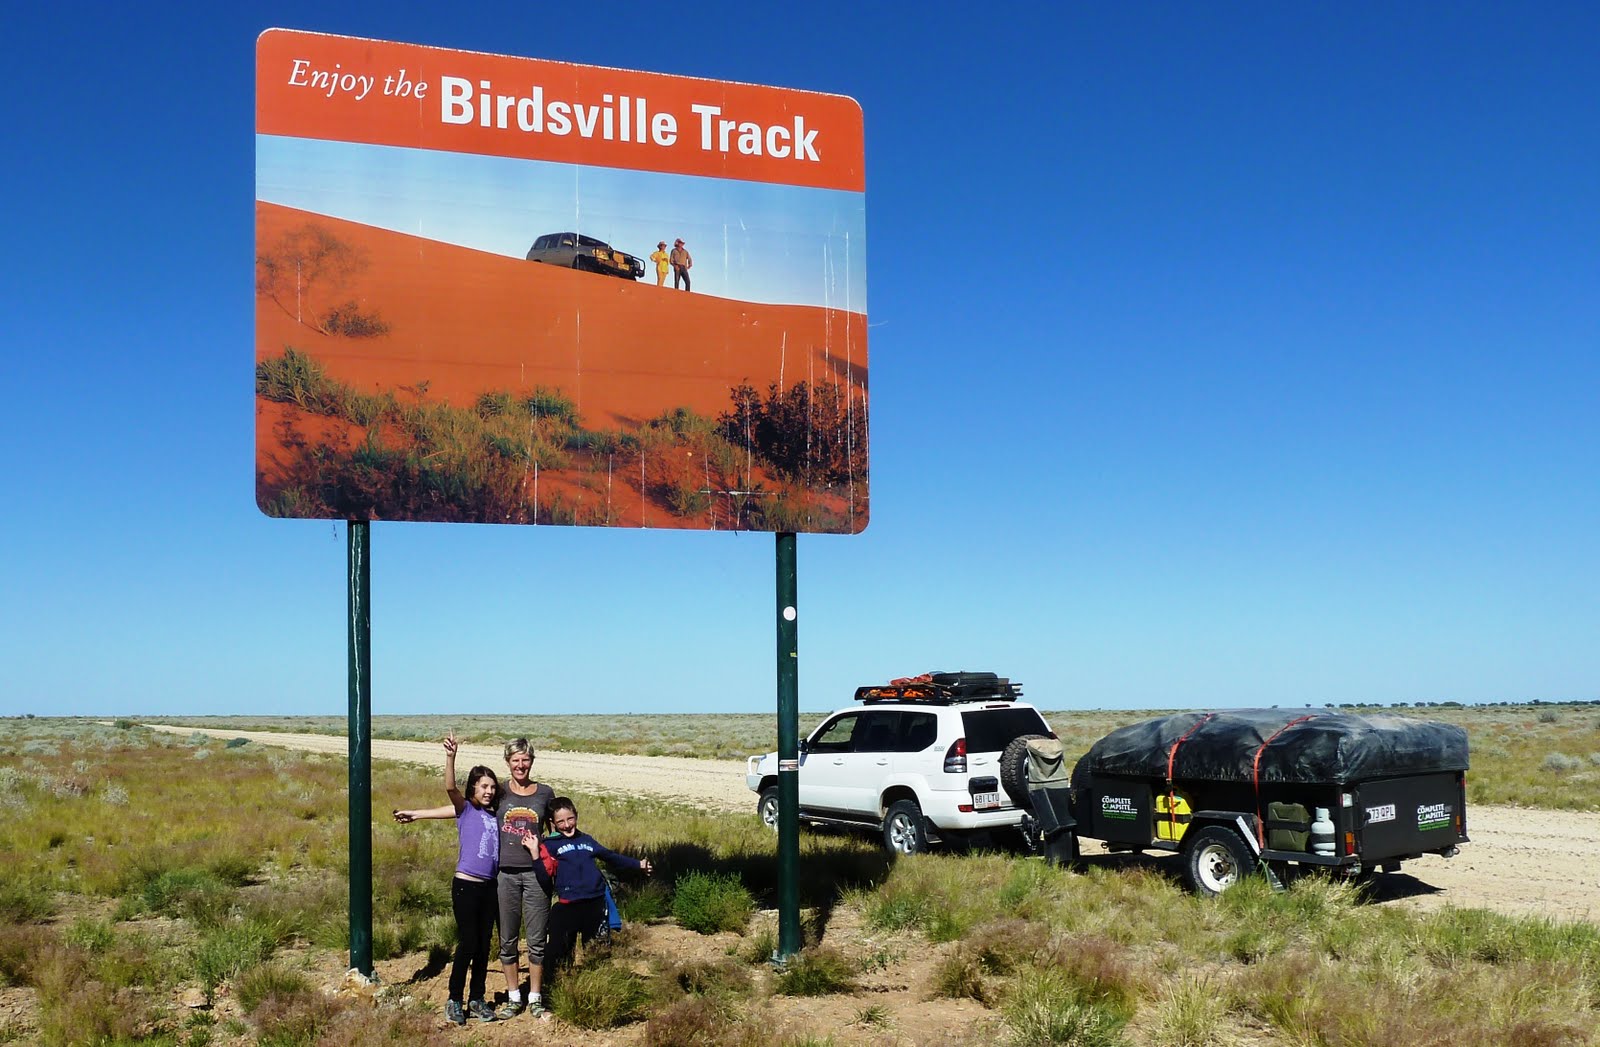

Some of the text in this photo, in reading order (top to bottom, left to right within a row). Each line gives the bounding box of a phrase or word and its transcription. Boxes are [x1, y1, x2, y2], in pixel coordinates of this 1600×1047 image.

[288, 59, 820, 162] Enjoy the Birdsville Track
[1101, 797, 1131, 805] COMPLETE
[1417, 804, 1445, 814] COMPLETE
